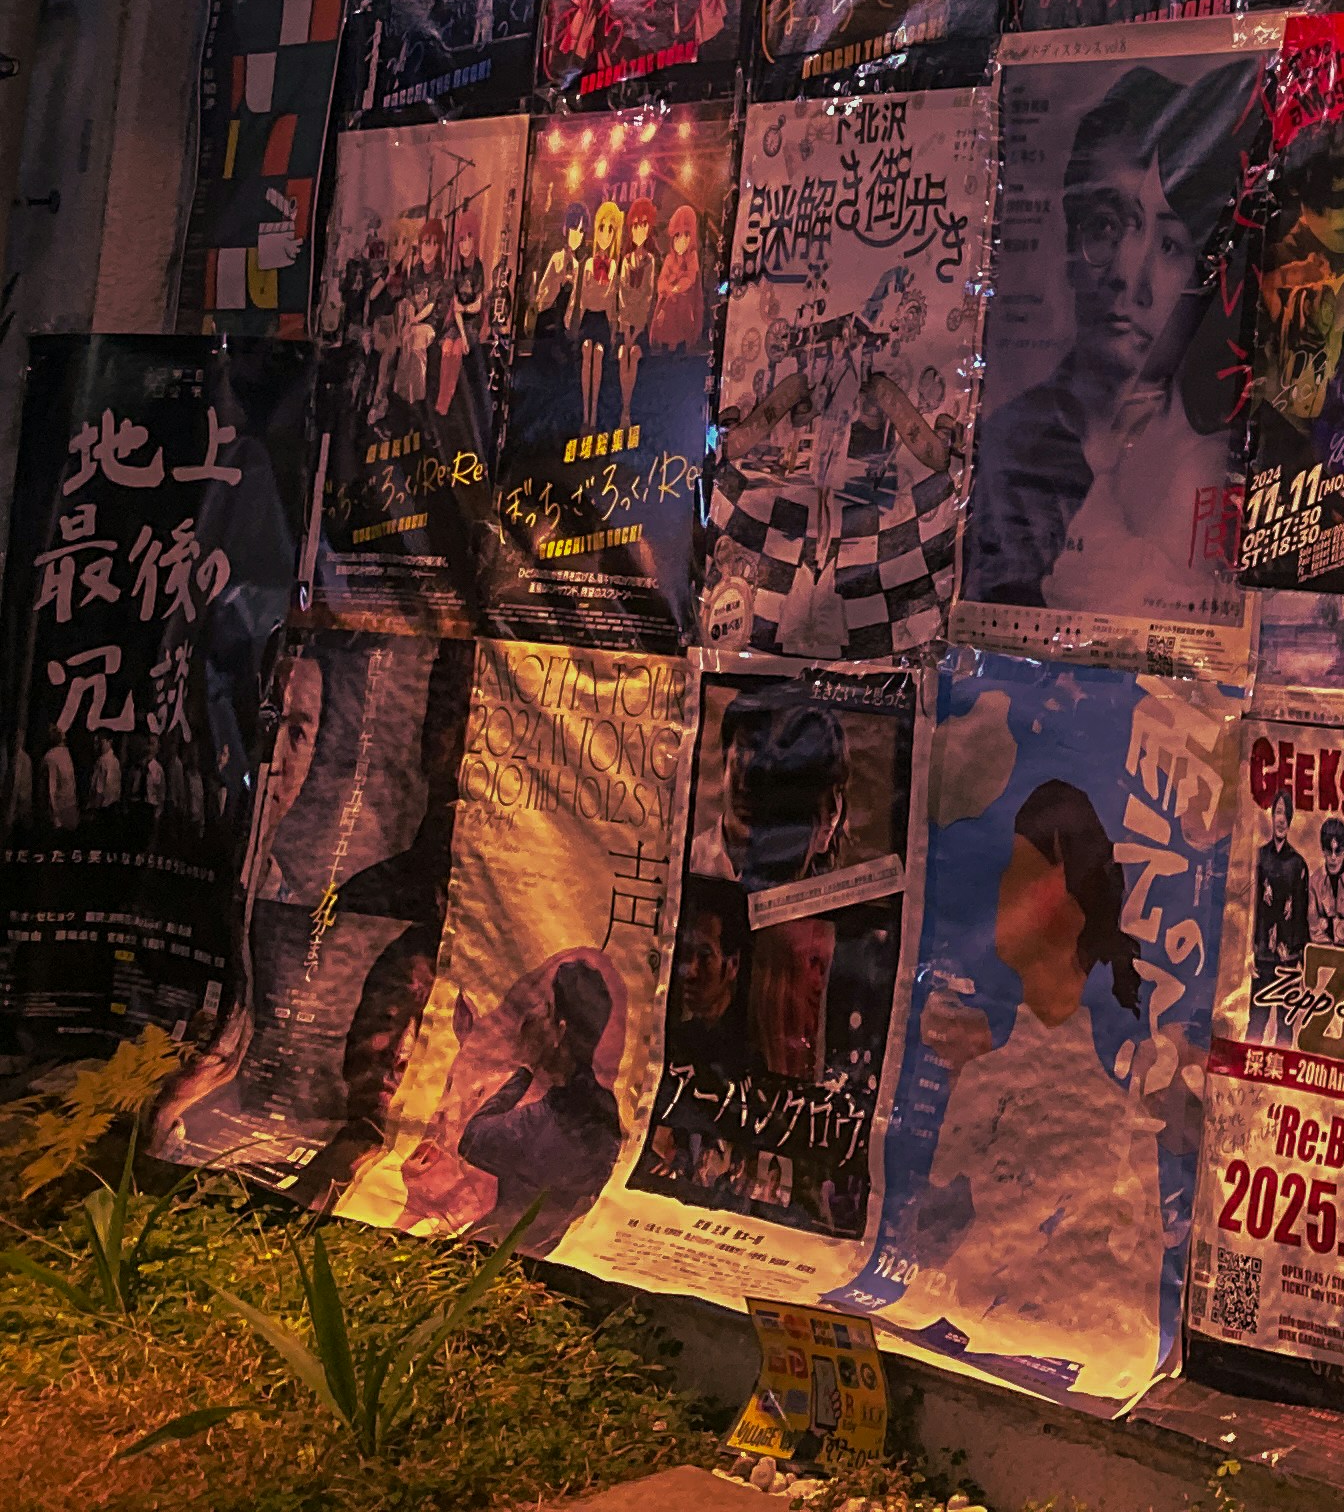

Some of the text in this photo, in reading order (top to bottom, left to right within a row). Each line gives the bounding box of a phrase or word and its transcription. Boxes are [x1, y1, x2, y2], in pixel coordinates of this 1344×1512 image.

[836, 98, 908, 145] 下北沢
[63, 408, 243, 496] 地上
[1251, 465, 1282, 491] 2024
[1246, 463, 1323, 531] 11.11
[1240, 524, 1321, 572] ST:18:30
[1242, 507, 1323, 555] OP:17:30
[32, 500, 231, 626] 最後の
[47, 643, 195, 746] 冗談
[611, 662, 686, 722] TOUR
[467, 704, 543, 763] 2024
[1254, 959, 1334, 1028] Zepp
